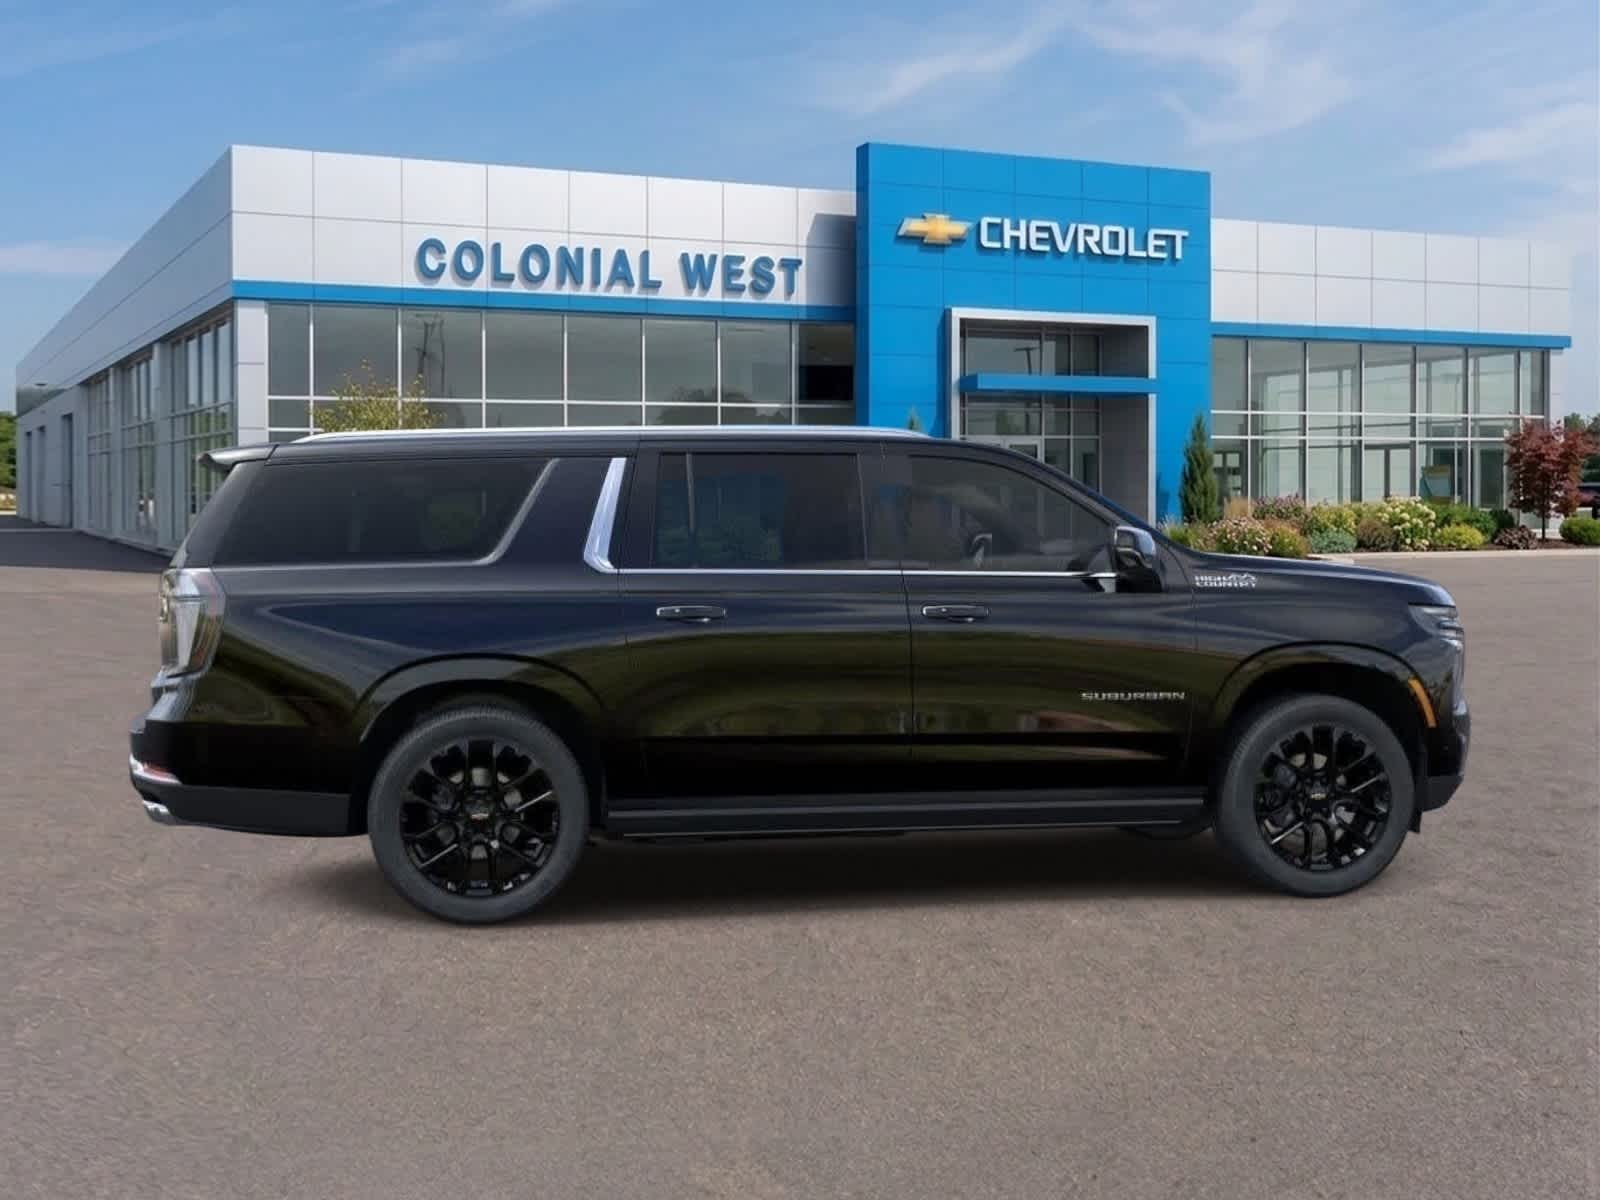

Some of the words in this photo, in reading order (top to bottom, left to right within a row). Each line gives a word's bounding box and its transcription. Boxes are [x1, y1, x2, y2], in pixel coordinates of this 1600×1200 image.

[979, 215, 1189, 260] CHEVROLET
[415, 237, 663, 290] COLONIAL
[679, 250, 804, 296] WEST
[1194, 581, 1258, 589] COUNTRY
[1080, 691, 1186, 701] SUBURBAN
